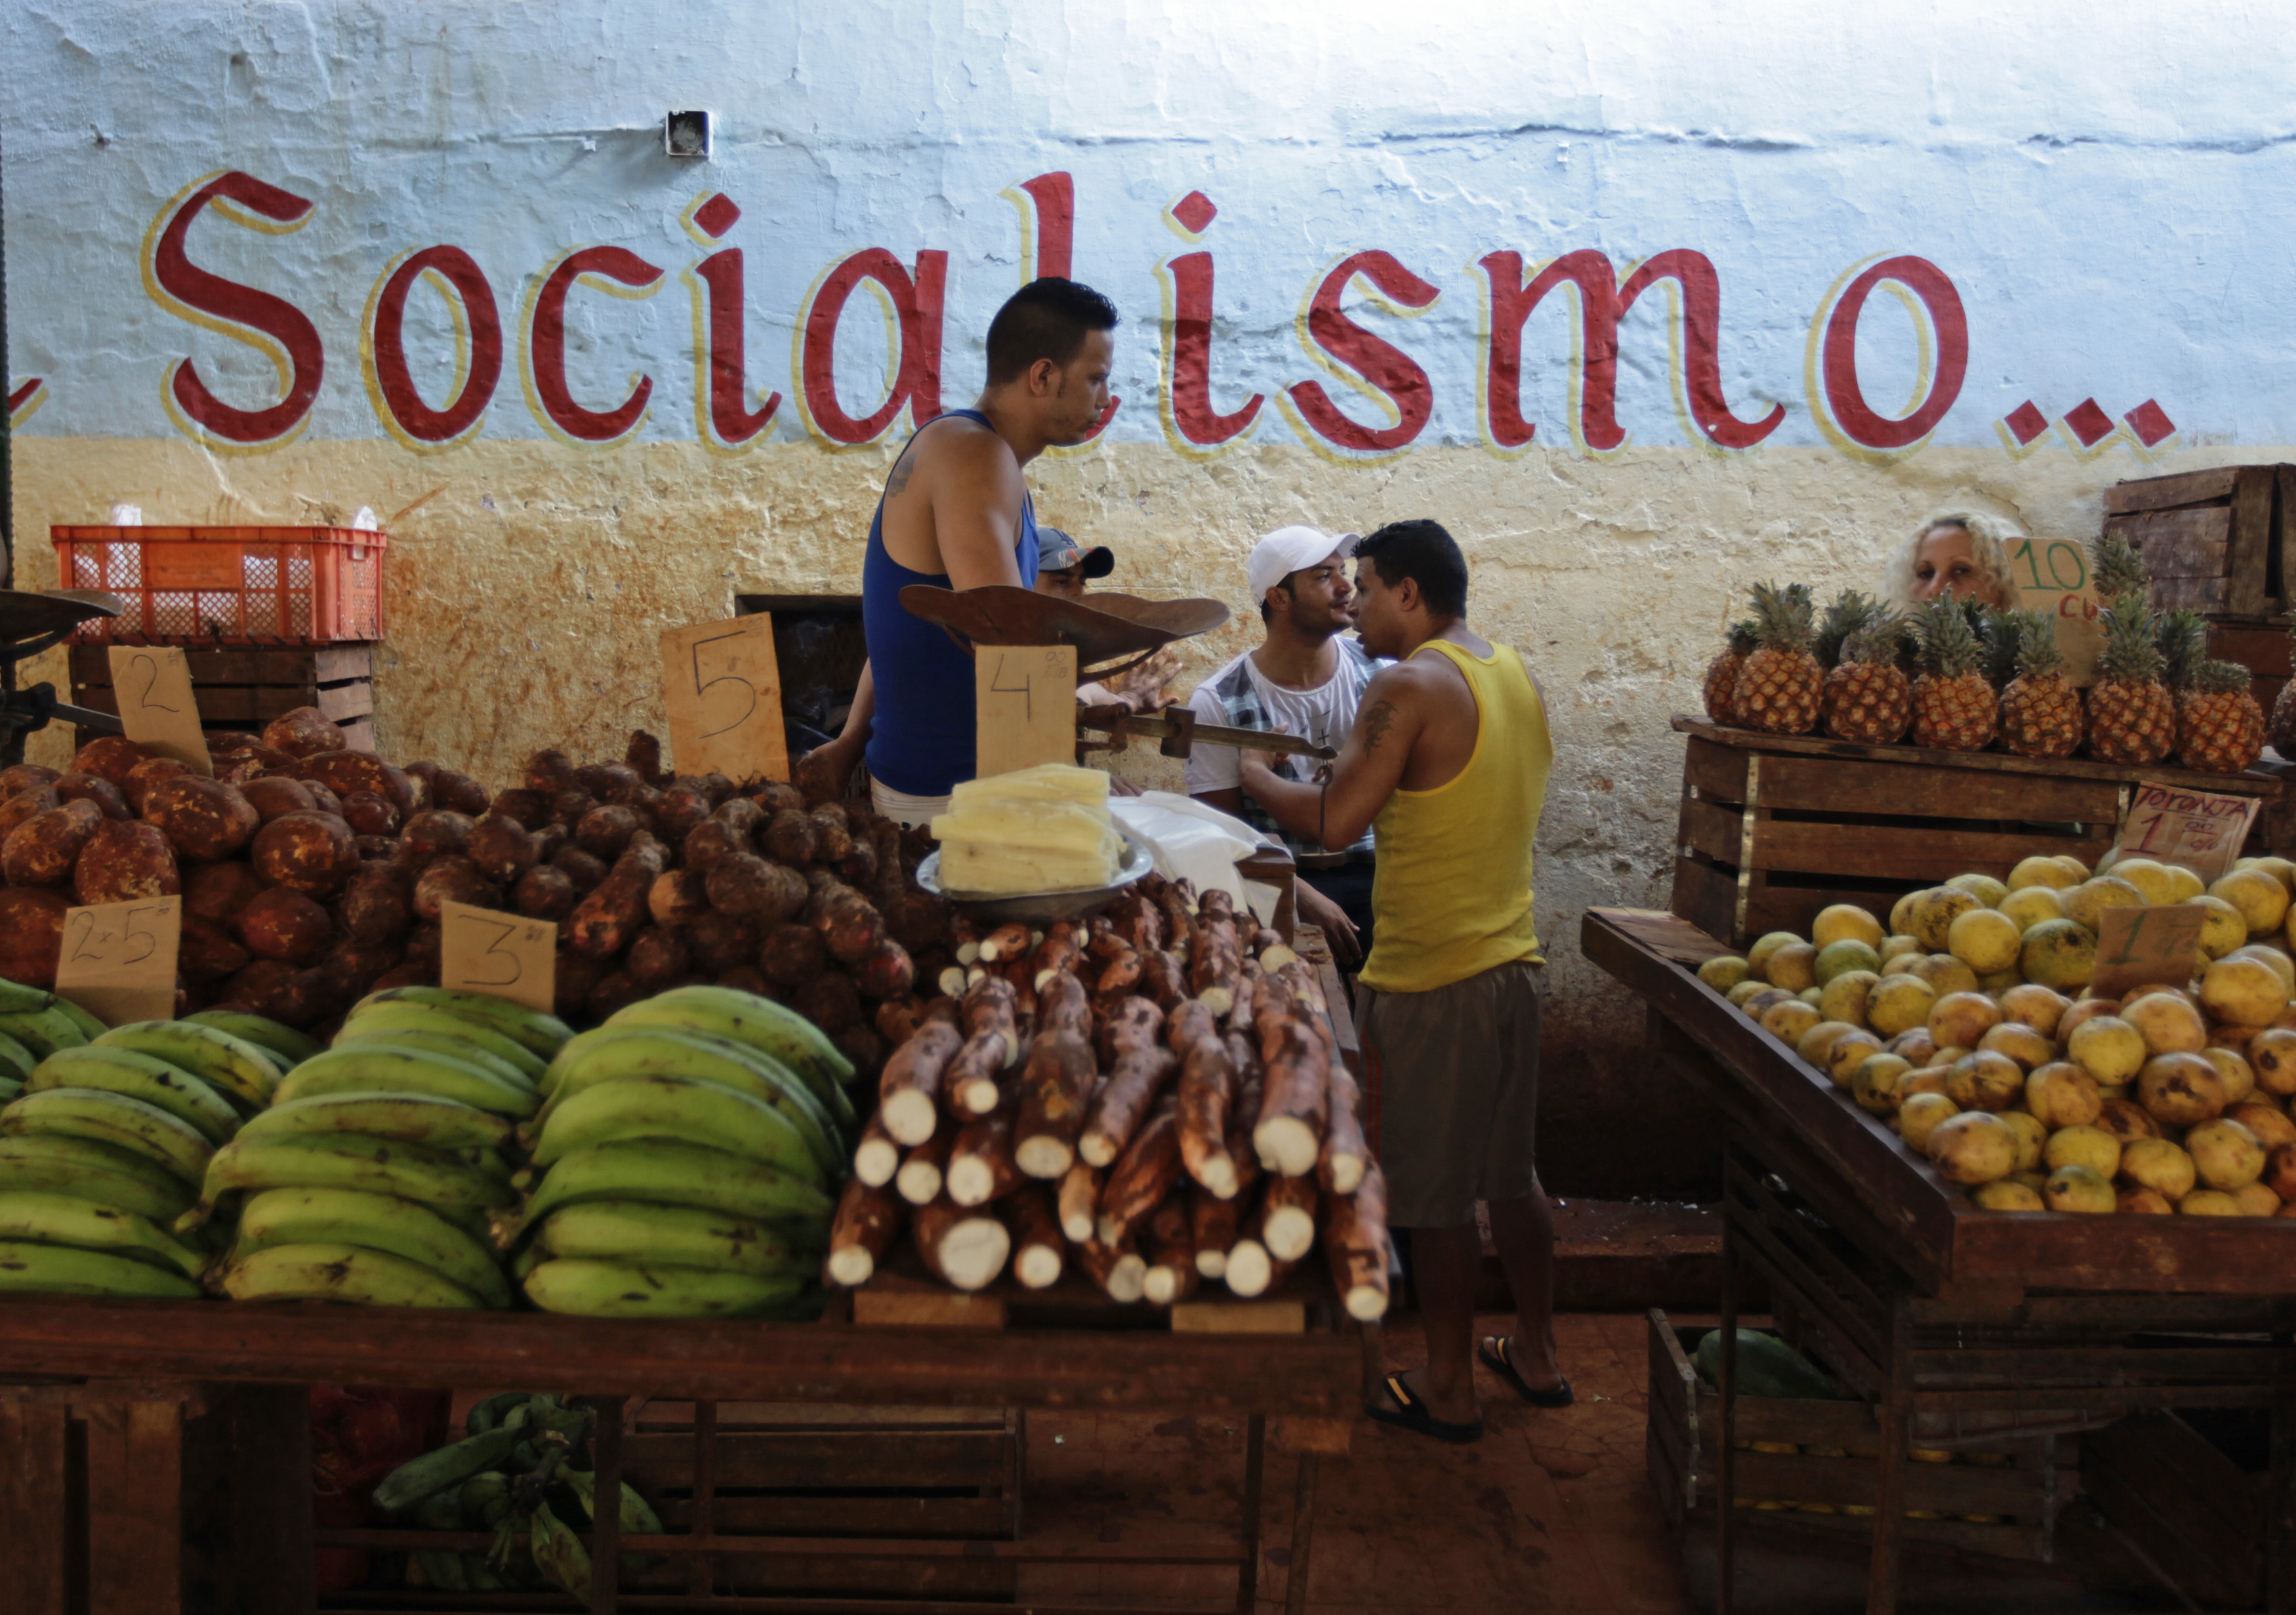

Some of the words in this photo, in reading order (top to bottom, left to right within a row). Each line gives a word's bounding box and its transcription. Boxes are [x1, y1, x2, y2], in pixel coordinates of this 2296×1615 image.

[2014, 538, 2086, 591] 10
[131, 654, 180, 713] 2
[692, 630, 756, 739] 5
[990, 652, 1032, 722] 4
[2123, 812, 2163, 856] 1
[459, 914, 522, 986] 3
